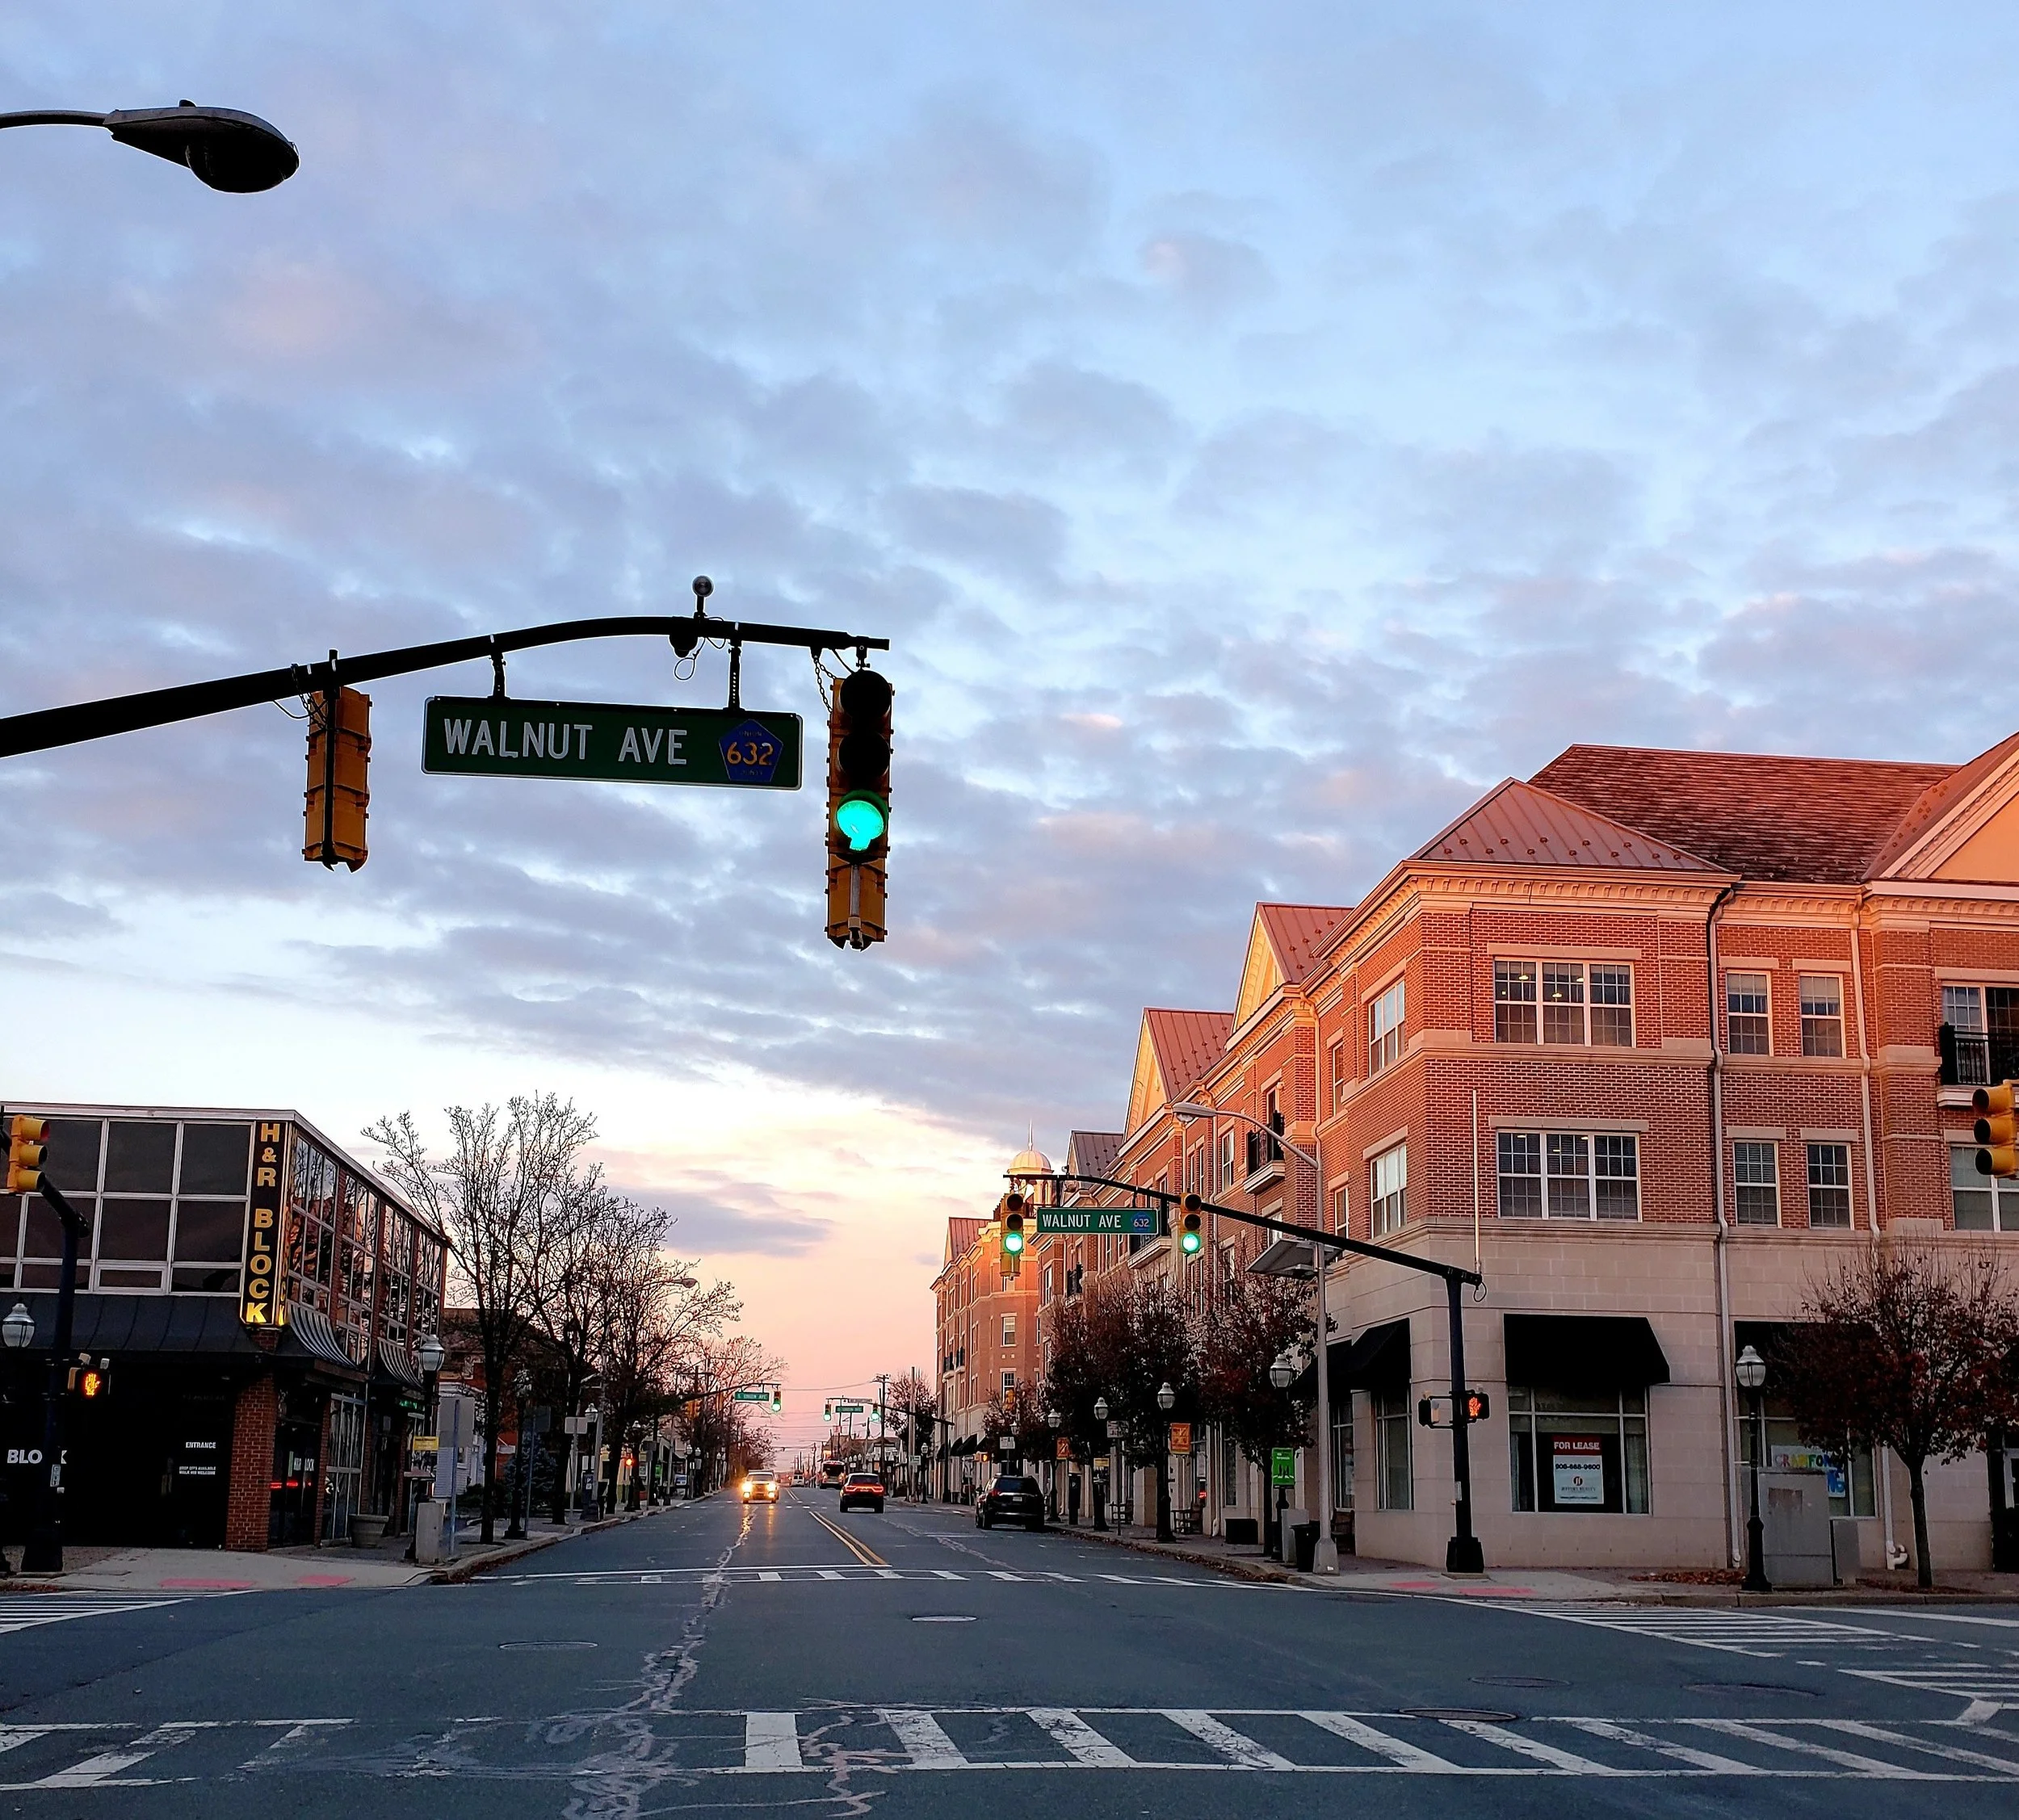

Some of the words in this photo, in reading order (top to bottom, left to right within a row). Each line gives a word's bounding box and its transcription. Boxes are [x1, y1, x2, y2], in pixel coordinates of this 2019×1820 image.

[443, 719, 593, 760] WALNUT
[618, 728, 687, 765] AVE
[727, 741, 774, 766] 632
[257, 1123, 280, 1187] H&R
[1042, 1214, 1091, 1227] WALNUT
[1098, 1214, 1122, 1228] AVE
[1134, 1218, 1148, 1227] 632
[246, 1209, 274, 1323] BLOCK
[185, 1441, 216, 1449] ENTRANCE
[1554, 1441, 1570, 1449] FOR
[6, 1449, 67, 1465] BLOK
